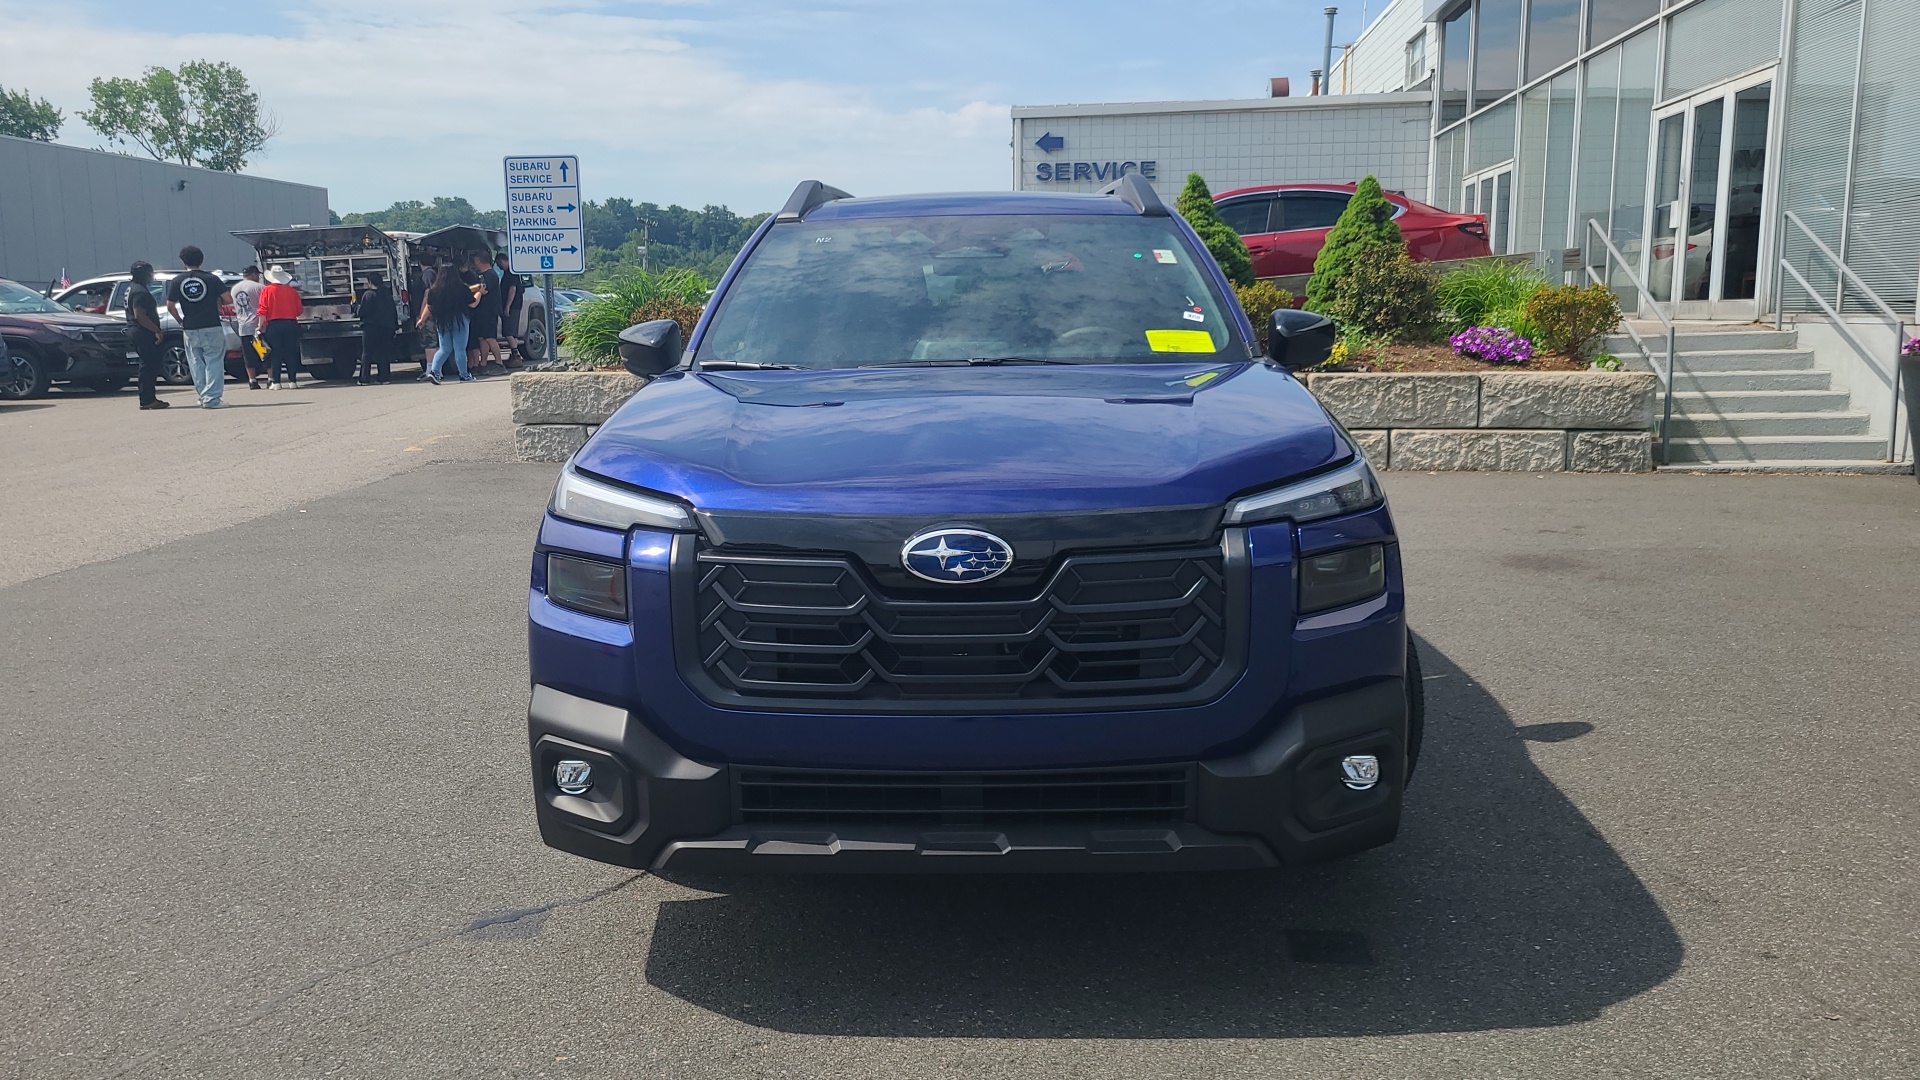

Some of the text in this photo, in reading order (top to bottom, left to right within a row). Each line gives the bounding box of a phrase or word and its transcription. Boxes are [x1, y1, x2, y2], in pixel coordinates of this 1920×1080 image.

[509, 162, 550, 171] SUBARU
[1036, 161, 1156, 182] SERVICE
[510, 175, 552, 184] SERVICE
[511, 192, 552, 202] SUBARU
[512, 205, 554, 214] SALES &
[513, 218, 557, 227] PARKING
[513, 233, 565, 242] HANDICAP
[514, 246, 559, 255] PARKING
